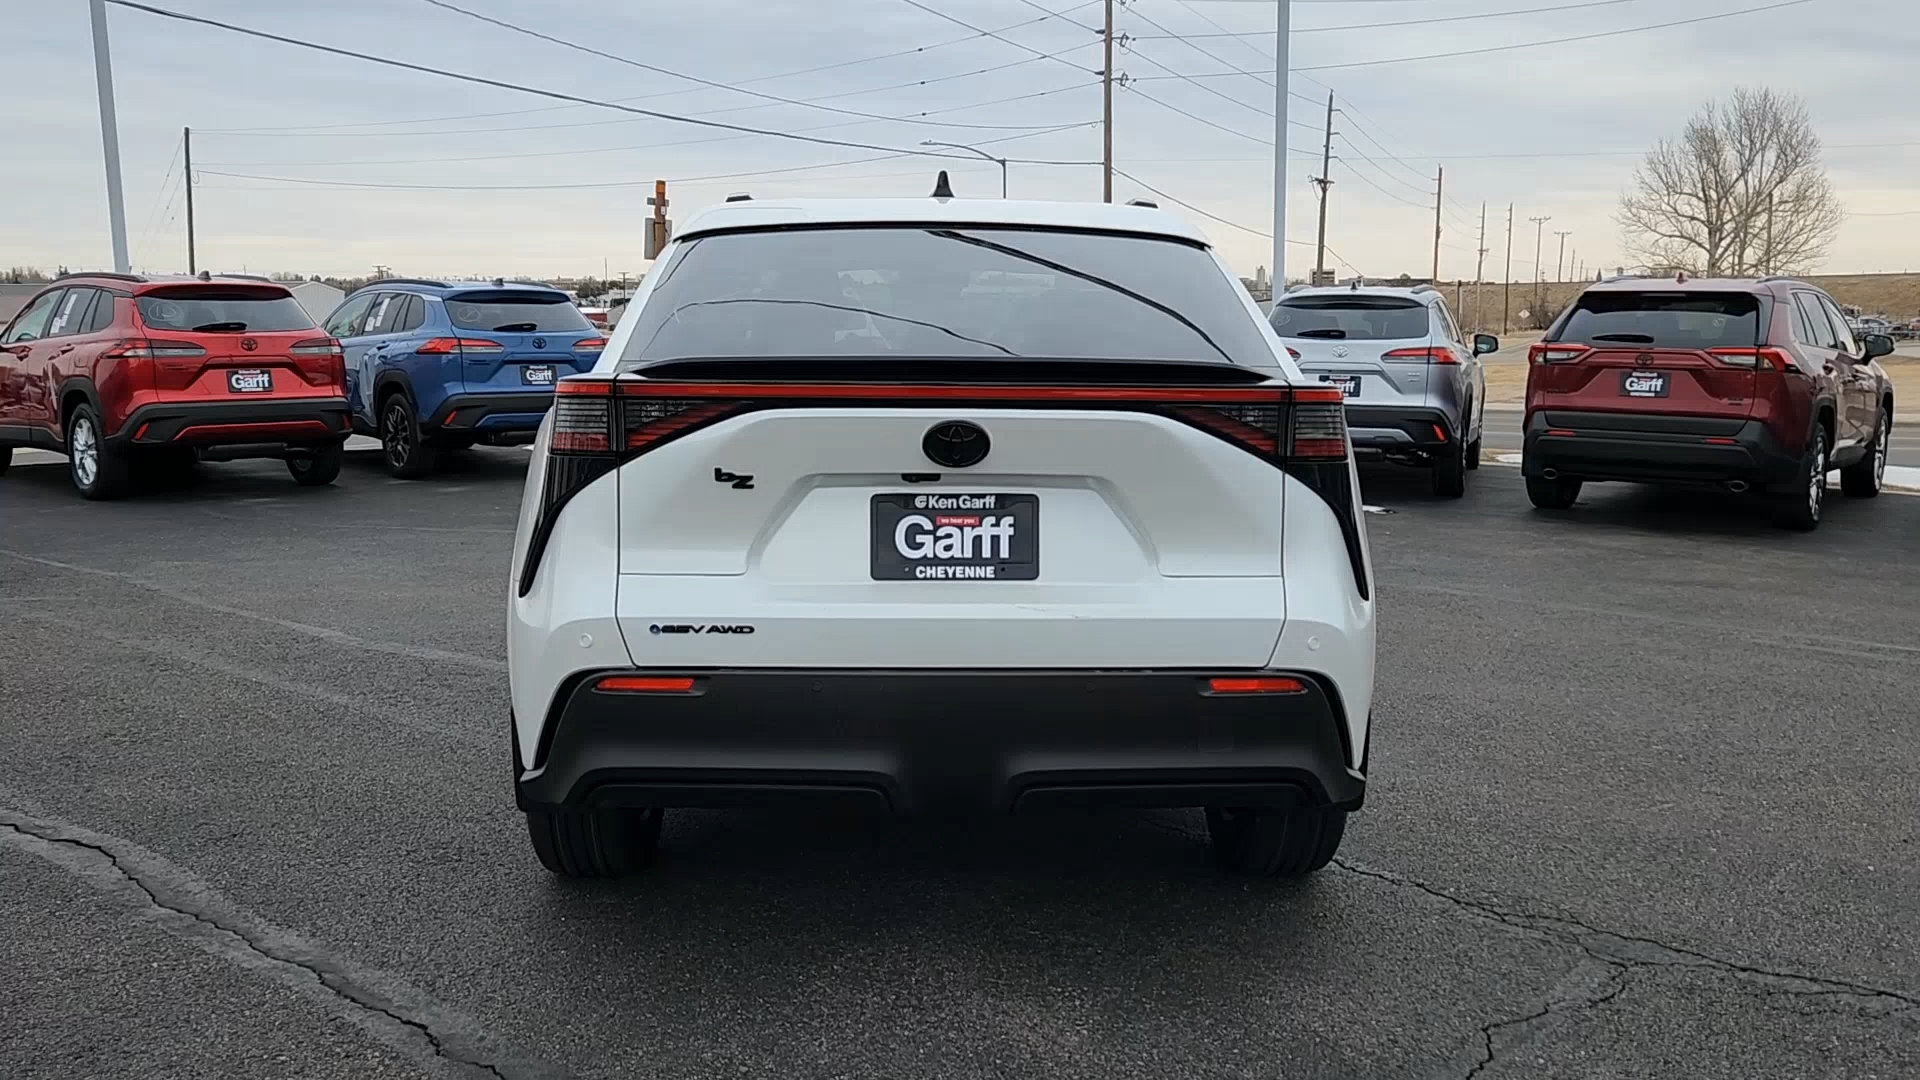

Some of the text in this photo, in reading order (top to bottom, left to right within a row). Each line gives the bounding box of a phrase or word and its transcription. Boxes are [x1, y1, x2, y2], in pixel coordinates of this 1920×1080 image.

[231, 373, 269, 389] Garff
[525, 369, 552, 381] Garff
[1625, 377, 1663, 392] Garff
[928, 495, 996, 509] Ken Garff
[895, 515, 1015, 559] Garff
[915, 566, 995, 578] CHEYENNE
[705, 624, 755, 634] AWD
